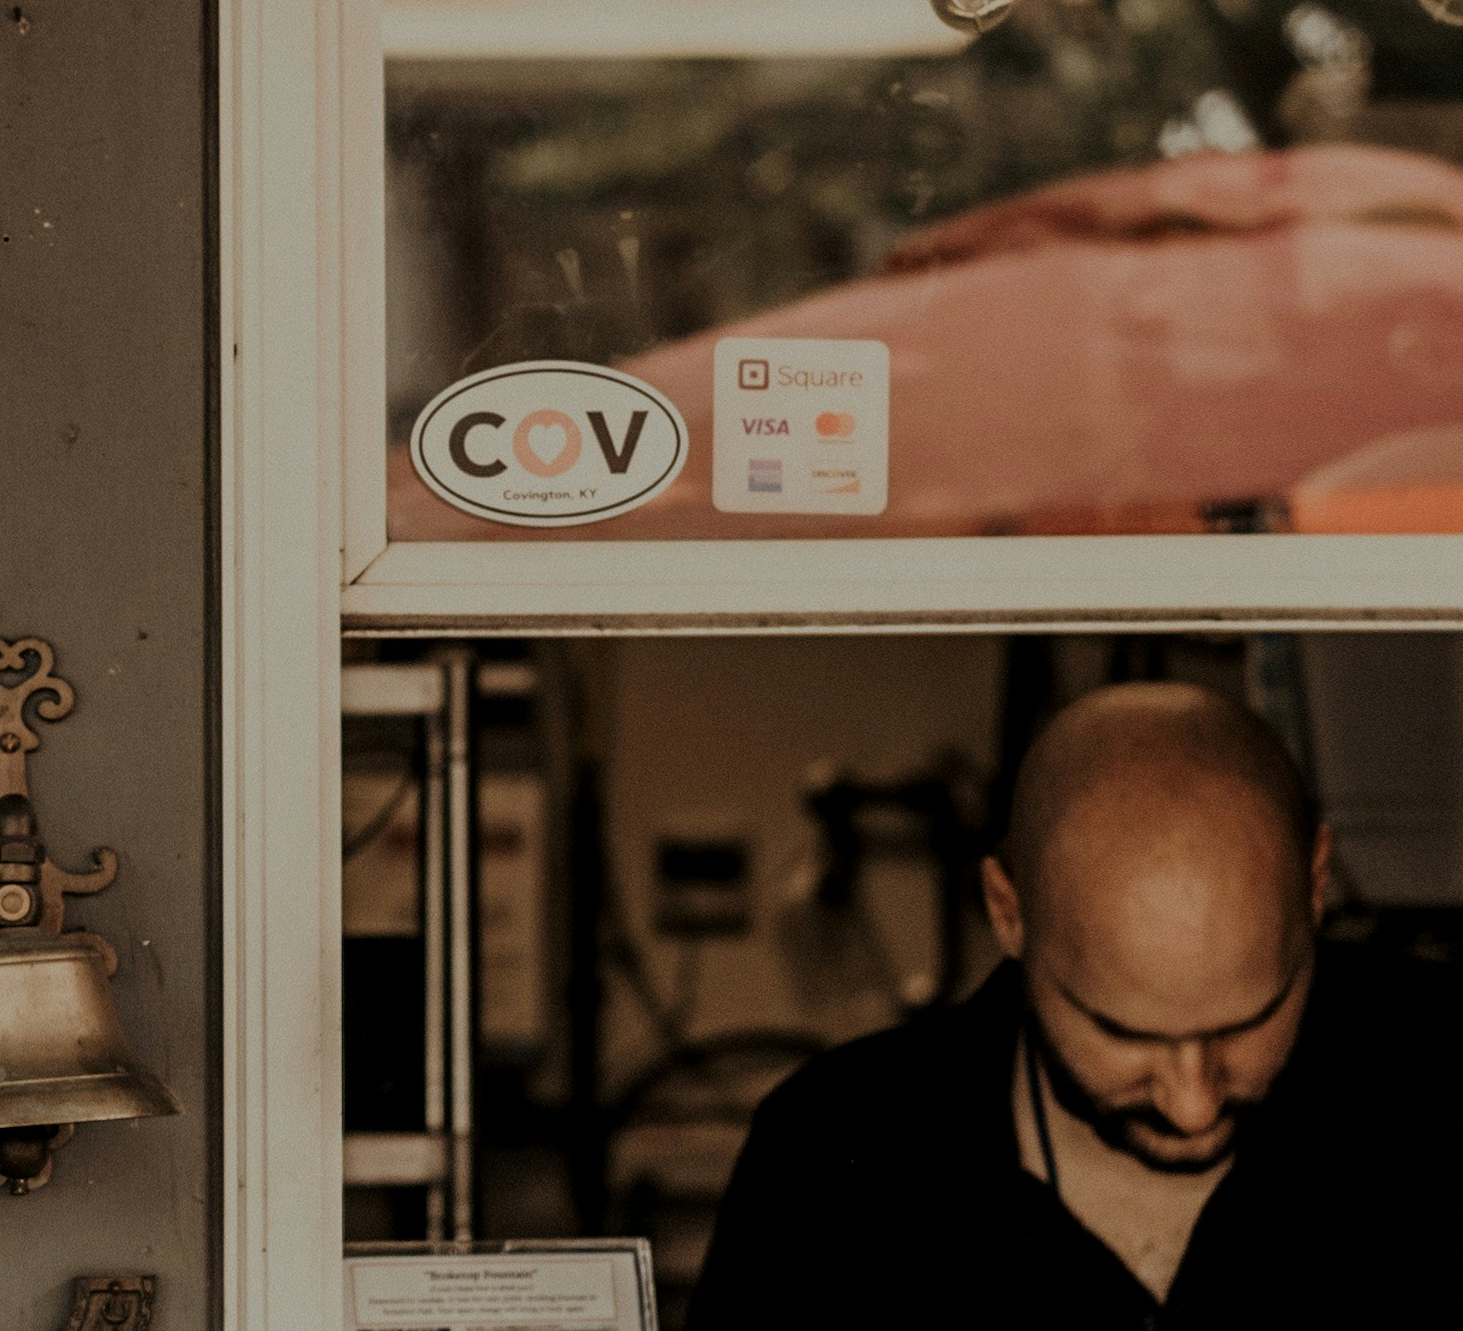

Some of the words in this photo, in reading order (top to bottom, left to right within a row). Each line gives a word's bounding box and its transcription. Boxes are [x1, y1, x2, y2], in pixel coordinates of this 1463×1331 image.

[777, 365, 864, 390] Square
[741, 417, 791, 436] VISA
[448, 408, 649, 478] COV
[503, 488, 575, 504] Covington,
[579, 489, 598, 500] KY
